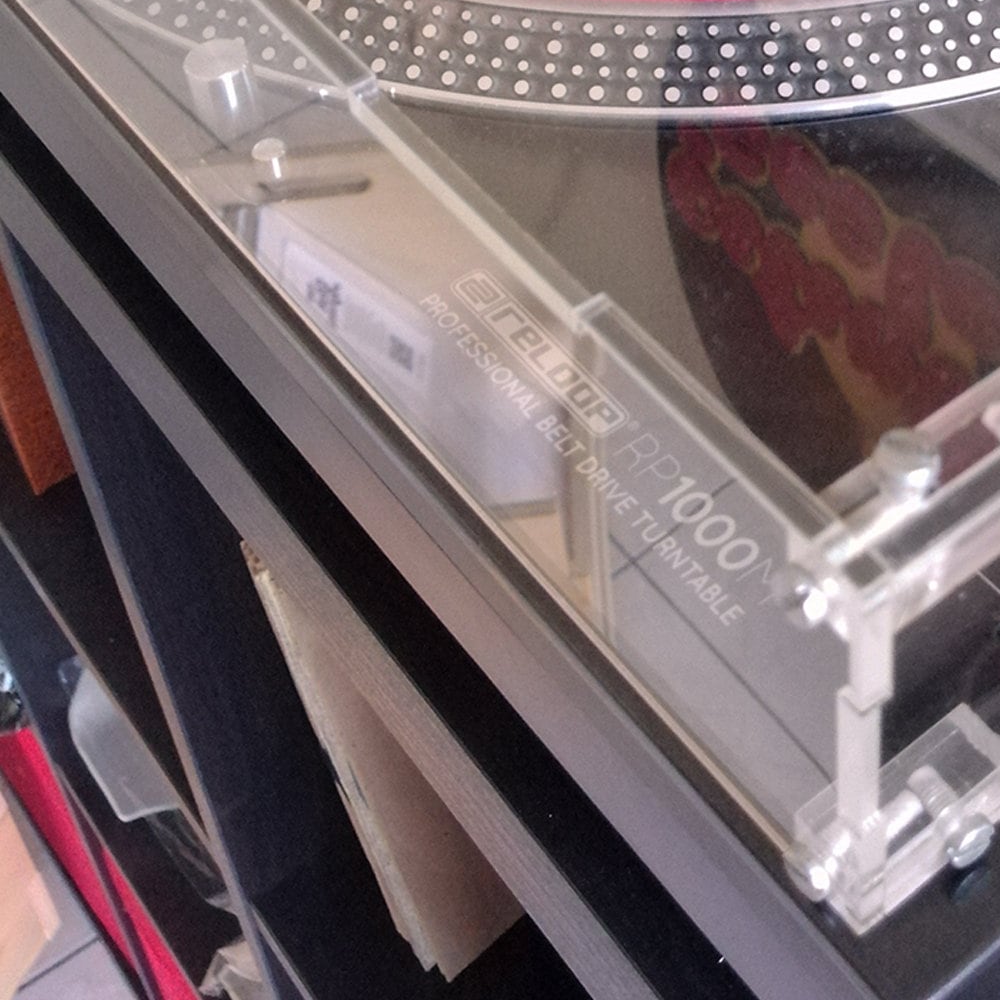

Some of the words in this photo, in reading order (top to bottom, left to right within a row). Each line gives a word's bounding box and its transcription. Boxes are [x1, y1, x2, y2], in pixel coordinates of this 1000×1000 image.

[418, 293, 541, 420] PROFESSIONAL
[535, 414, 586, 457] BELT
[575, 456, 640, 515] DRIVE
[631, 509, 746, 627] TURNTABLE
